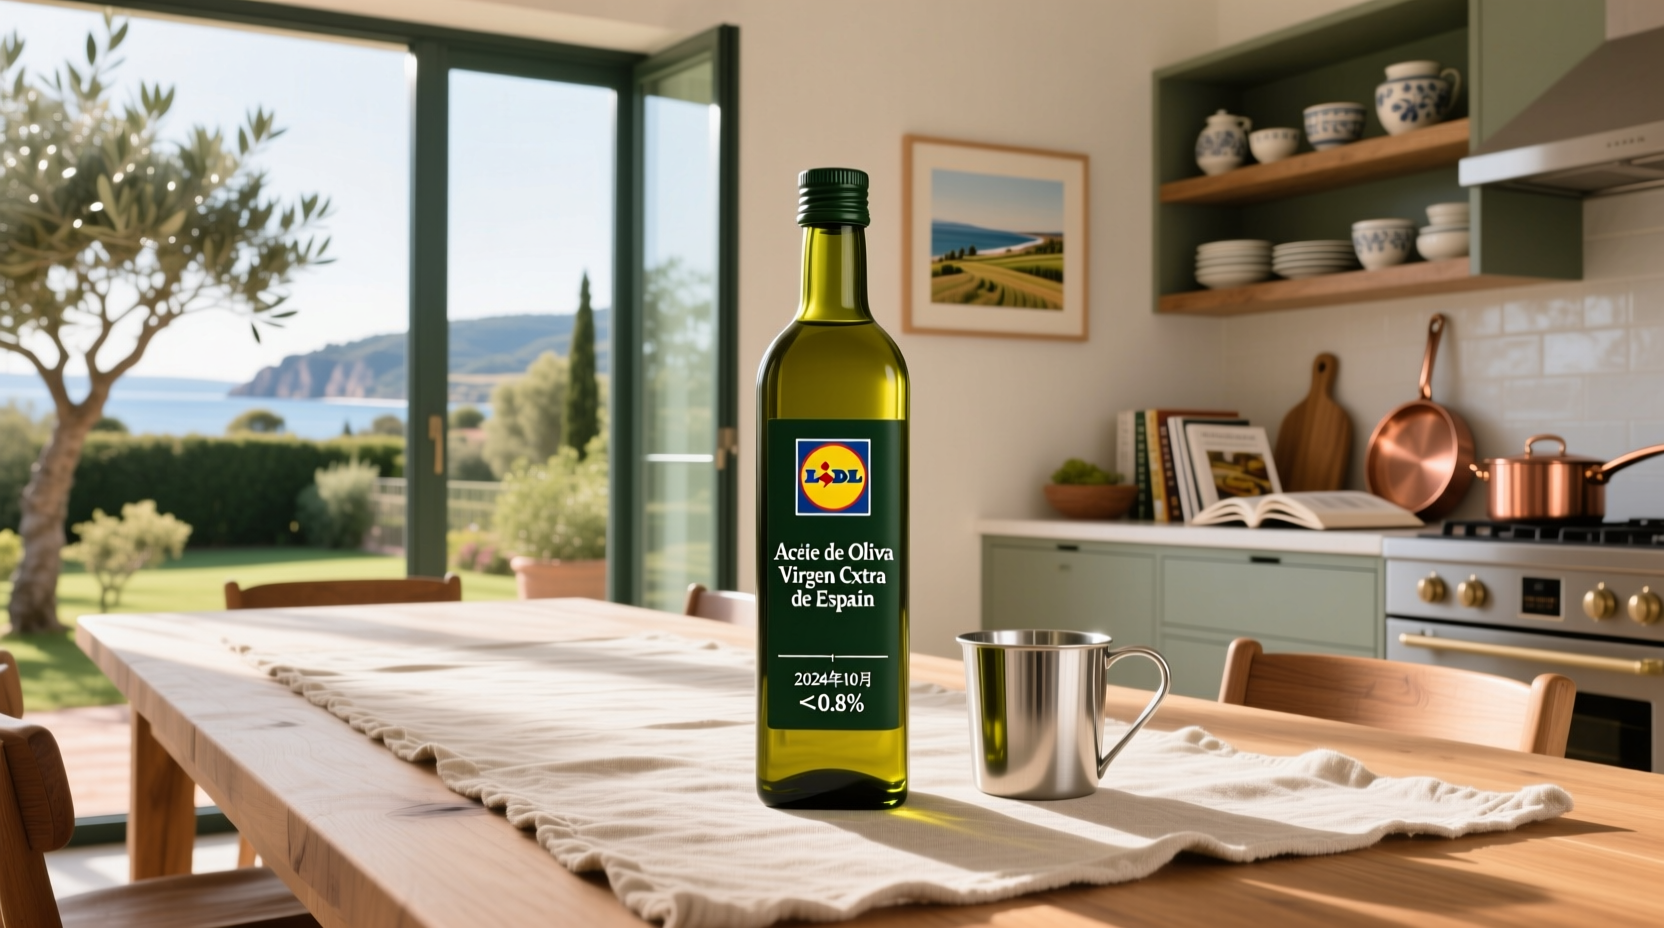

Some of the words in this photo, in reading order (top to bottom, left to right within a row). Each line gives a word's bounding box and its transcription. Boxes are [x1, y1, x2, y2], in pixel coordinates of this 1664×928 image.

[824, 542, 845, 561] de
[848, 542, 894, 561] Oliva
[778, 565, 836, 589] Virgen
[791, 589, 812, 607] de
[816, 589, 875, 613] Espain
[794, 670, 871, 688] 2024年10月
[799, 693, 865, 713] <0.8%
